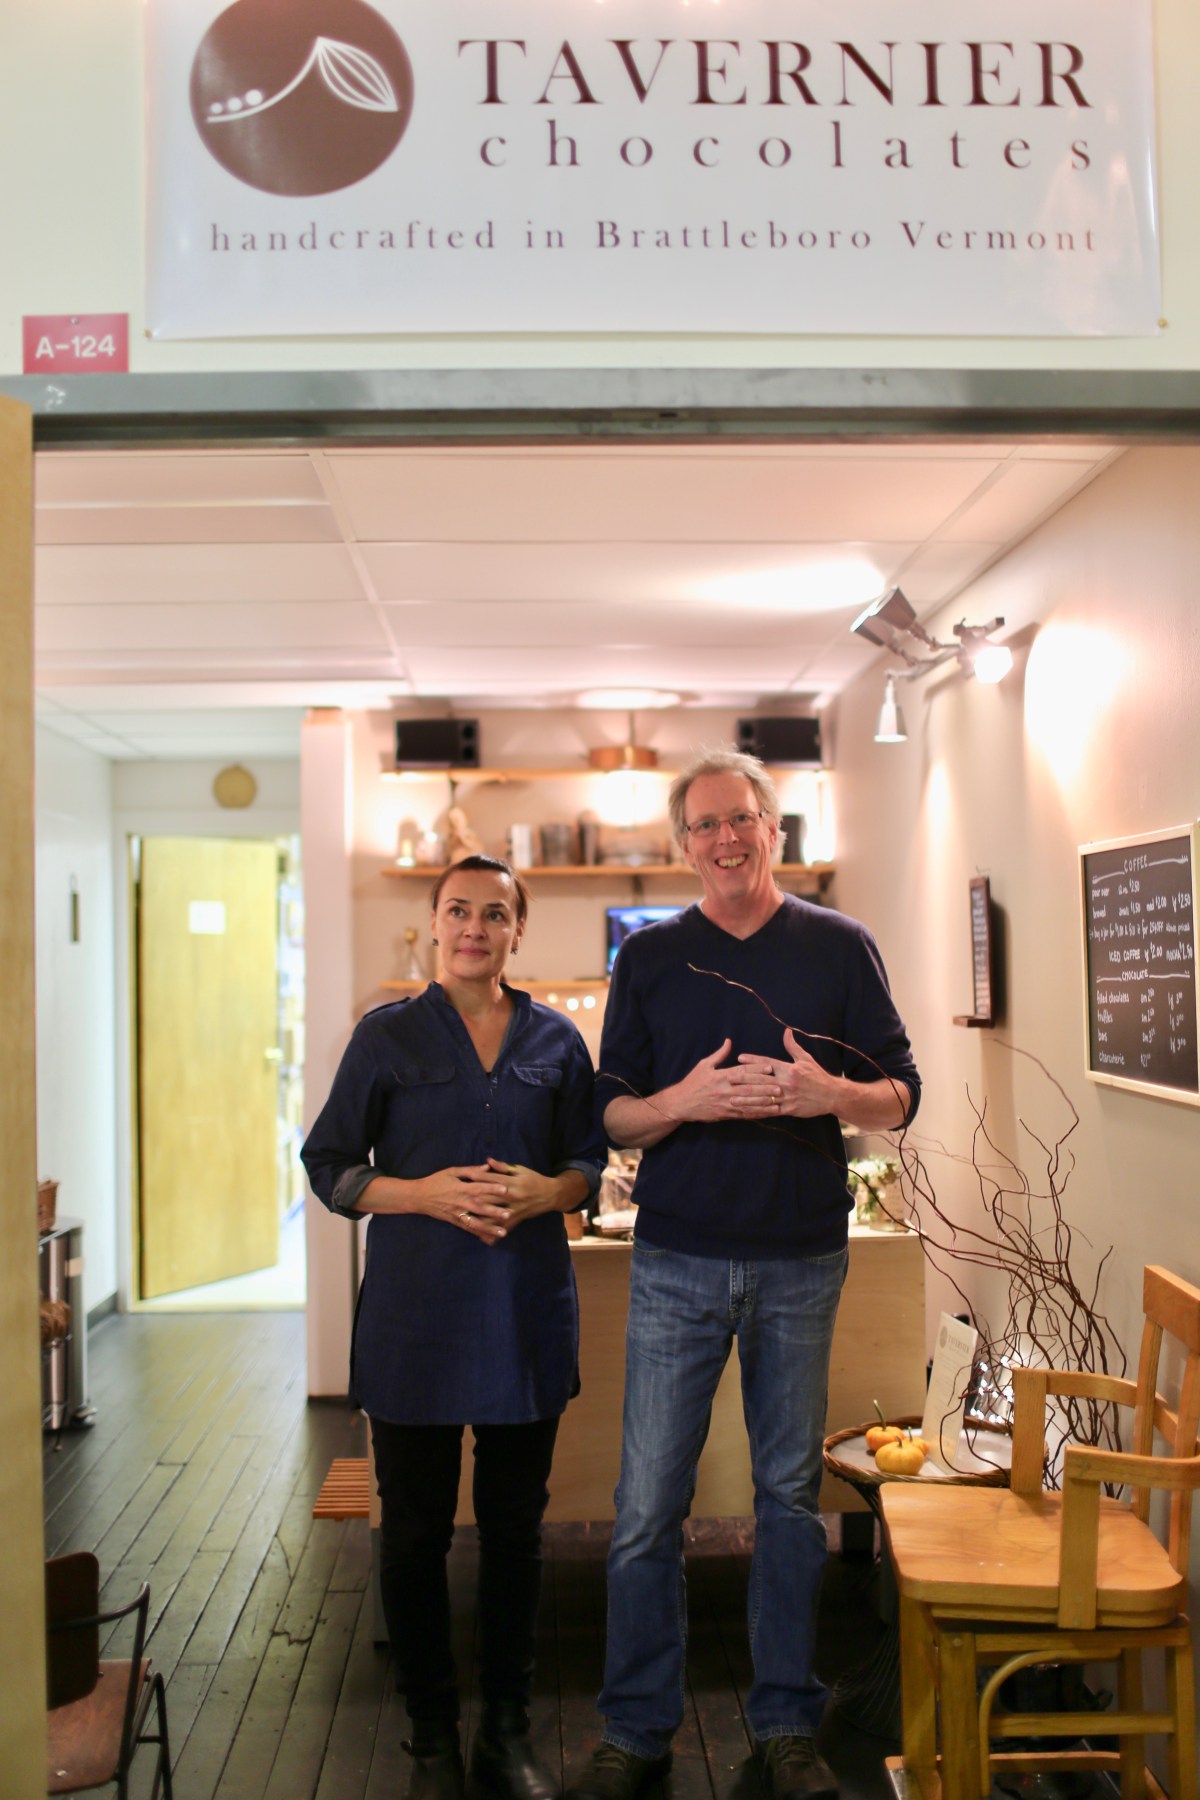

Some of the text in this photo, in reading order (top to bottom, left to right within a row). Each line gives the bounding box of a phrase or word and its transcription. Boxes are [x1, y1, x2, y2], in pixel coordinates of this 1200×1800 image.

[458, 40, 1093, 107] TAVERNIER
[480, 119, 1092, 169] chocolates
[210, 220, 1096, 252] handcrafted in Brattleboro Vermont
[35, 335, 116, 358] A-124
[1124, 854, 1148, 873] COFFEE
[1109, 949, 1120, 963] ICED
[1123, 948, 1140, 962] COFFEE
[1122, 968, 1148, 982] CHOCOLATE
